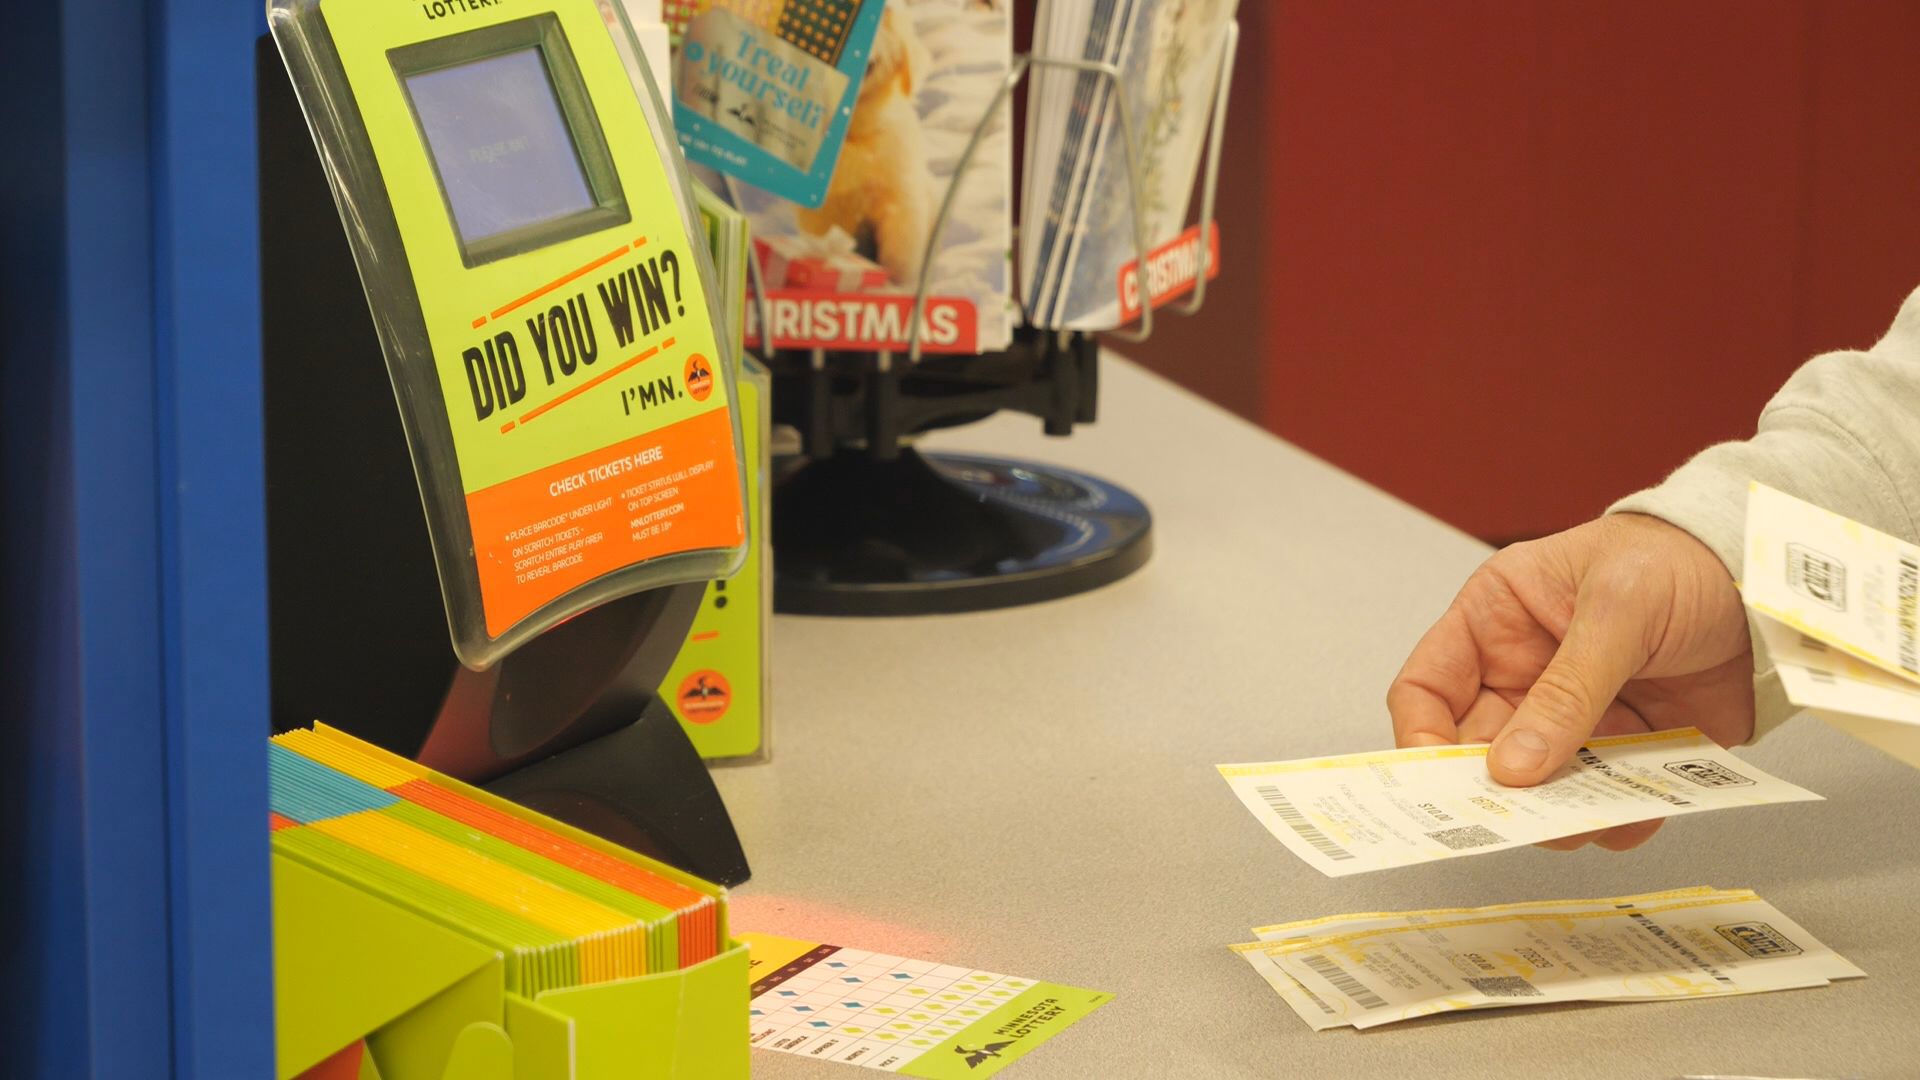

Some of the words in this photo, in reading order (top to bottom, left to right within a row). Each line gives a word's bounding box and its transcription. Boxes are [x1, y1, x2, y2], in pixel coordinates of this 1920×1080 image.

[462, 331, 527, 422] DID
[526, 292, 598, 386] YOU
[597, 249, 685, 348] WIN?
[745, 298, 959, 345] HRISTMAS
[549, 472, 588, 497] CHECK
[588, 456, 633, 483] TICKETS
[634, 446, 663, 468] HERE
[626, 483, 648, 499] TICKET
[647, 475, 673, 490] STATUS
[628, 501, 639, 511] ON
[639, 495, 653, 508] TOP
[653, 486, 679, 503] SCREEN
[510, 525, 533, 541] PLACE
[569, 504, 593, 519] UNDER
[593, 496, 613, 512] LIGHT
[632, 527, 650, 541] MUST
[650, 524, 660, 535] BE
[512, 548, 524, 558] ON
[524, 535, 554, 555] SCRATCH
[555, 526, 581, 543] TICKETS
[514, 553, 544, 572] SCRATCH
[545, 544, 569, 561] ENTIRE
[569, 539, 585, 552] PLAY
[585, 531, 604, 546] AREA
[526, 565, 552, 581] REVEAL
[552, 552, 584, 572] BARCODE
[993, 998, 1059, 1036] MINNESOTA
[1009, 1005, 1066, 1039] LOTTERY
